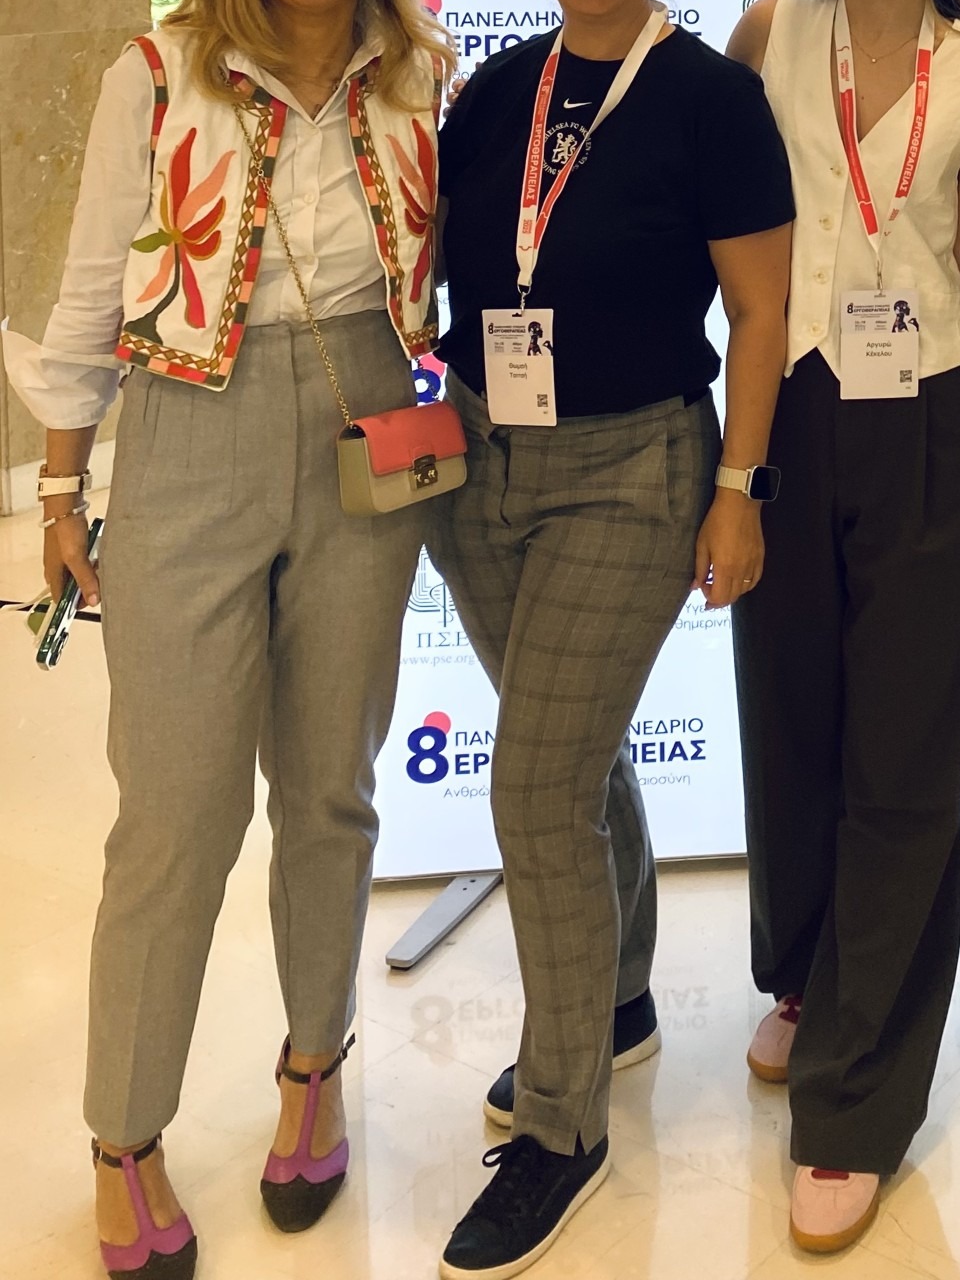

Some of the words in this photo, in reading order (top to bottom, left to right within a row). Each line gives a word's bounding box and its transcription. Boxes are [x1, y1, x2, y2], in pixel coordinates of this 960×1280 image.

[446, 11, 564, 28] ΠΑΝΕΛΛΗΝ
[545, 122, 569, 142] HELSEA
[526, 123, 543, 200] ΕΡΓΟΘΕΡΑΠΕΙΑΣ
[675, 616, 731, 631] θημερινή
[416, 631, 470, 648] Π.Σ.Ε
[630, 717, 704, 736] ΝΕΔΡΙΟ
[406, 725, 449, 784] 8
[638, 772, 691, 786] αιοσύνη
